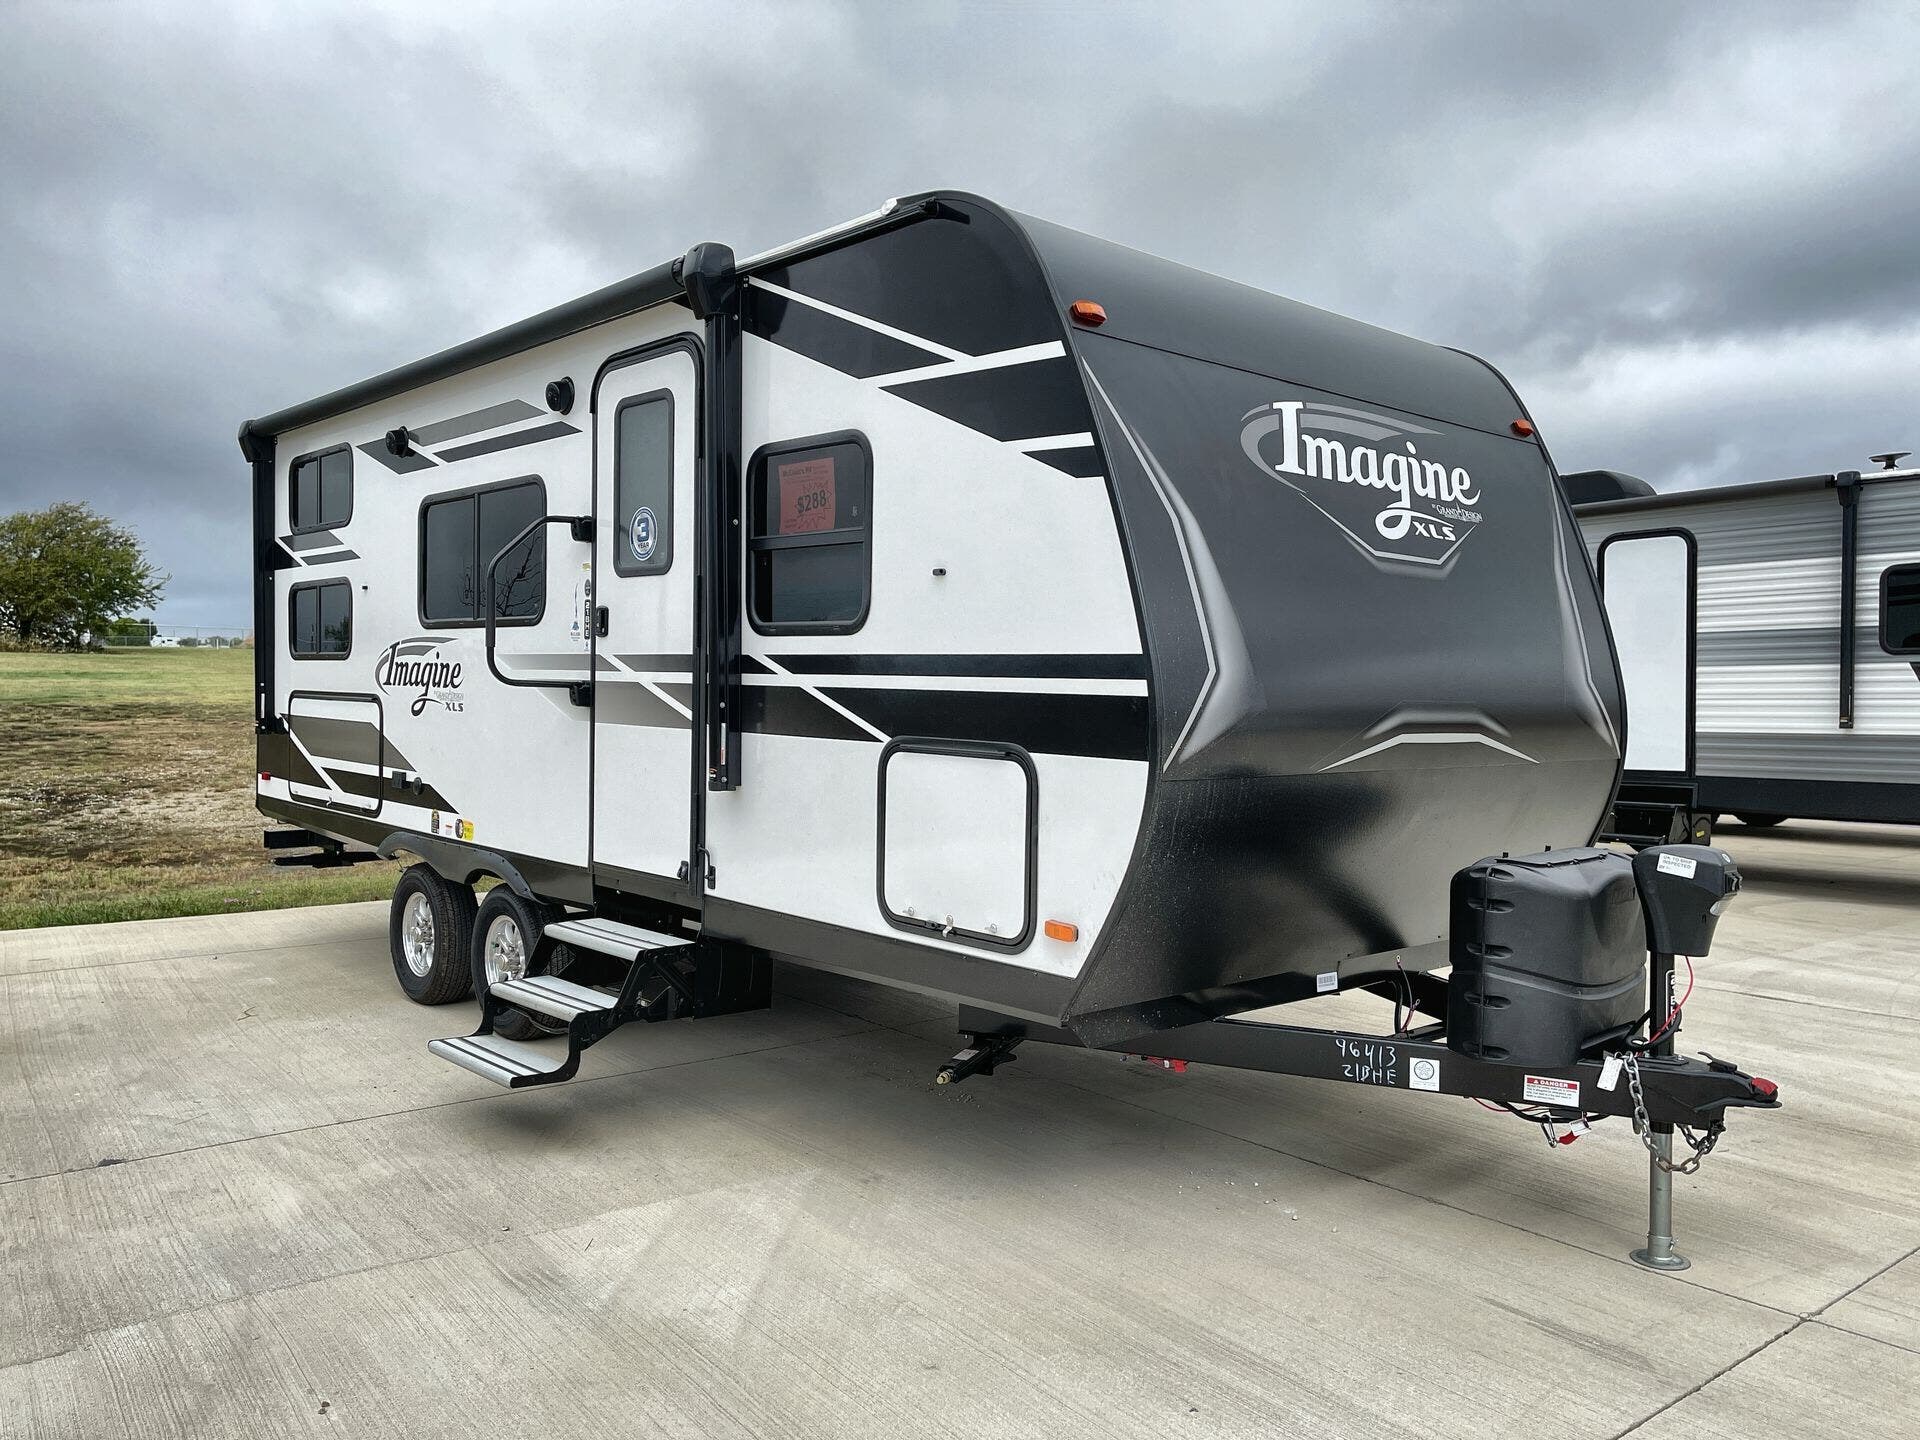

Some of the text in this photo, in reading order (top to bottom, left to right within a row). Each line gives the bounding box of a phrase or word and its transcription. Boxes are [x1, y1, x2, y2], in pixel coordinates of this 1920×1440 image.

[1272, 401, 1481, 540] Imagine
[797, 490, 827, 513] $288
[637, 517, 650, 542] 3
[1413, 522, 1456, 541] XLS
[382, 641, 464, 717] Imagine
[445, 702, 464, 712] XLS
[1540, 1080, 1569, 1088] DANGER
